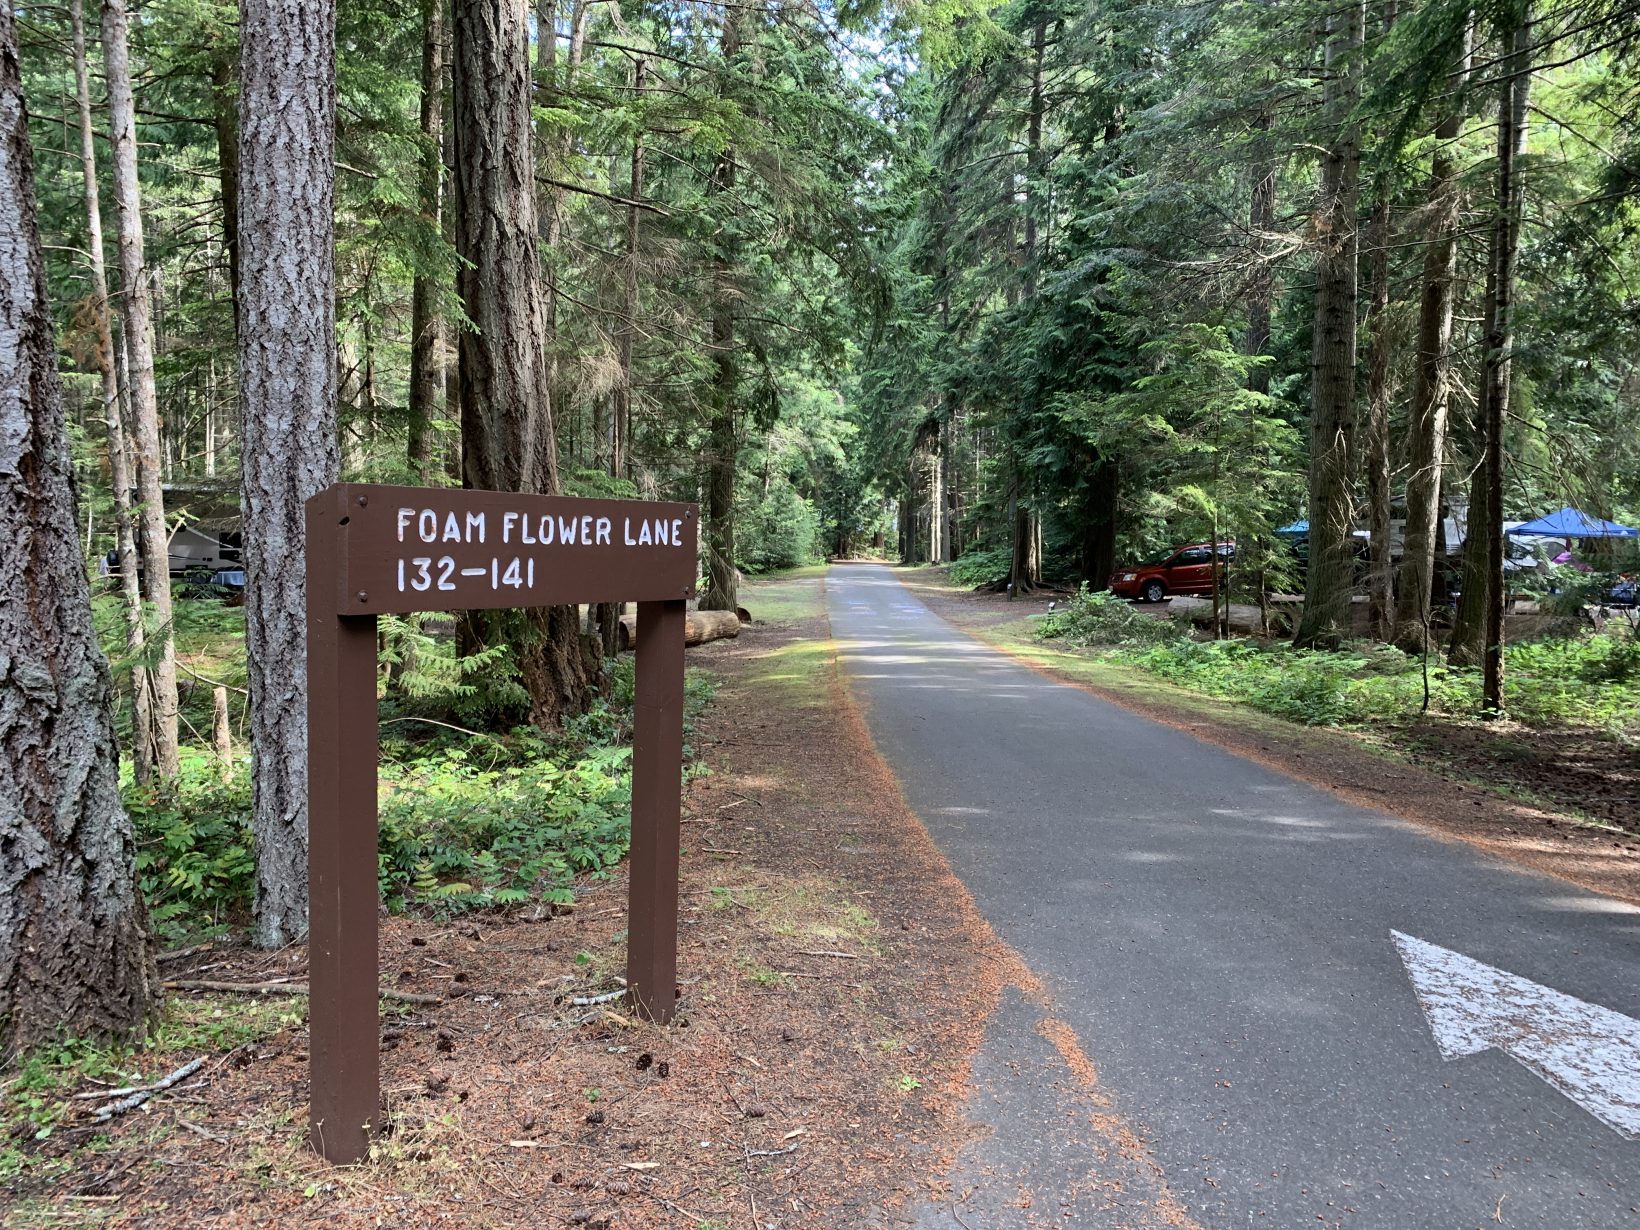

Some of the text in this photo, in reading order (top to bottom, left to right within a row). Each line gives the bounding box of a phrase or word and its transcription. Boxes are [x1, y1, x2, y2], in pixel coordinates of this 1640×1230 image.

[397, 507, 683, 547] FOAM FLOWER LANE
[397, 555, 534, 592] 132-141
